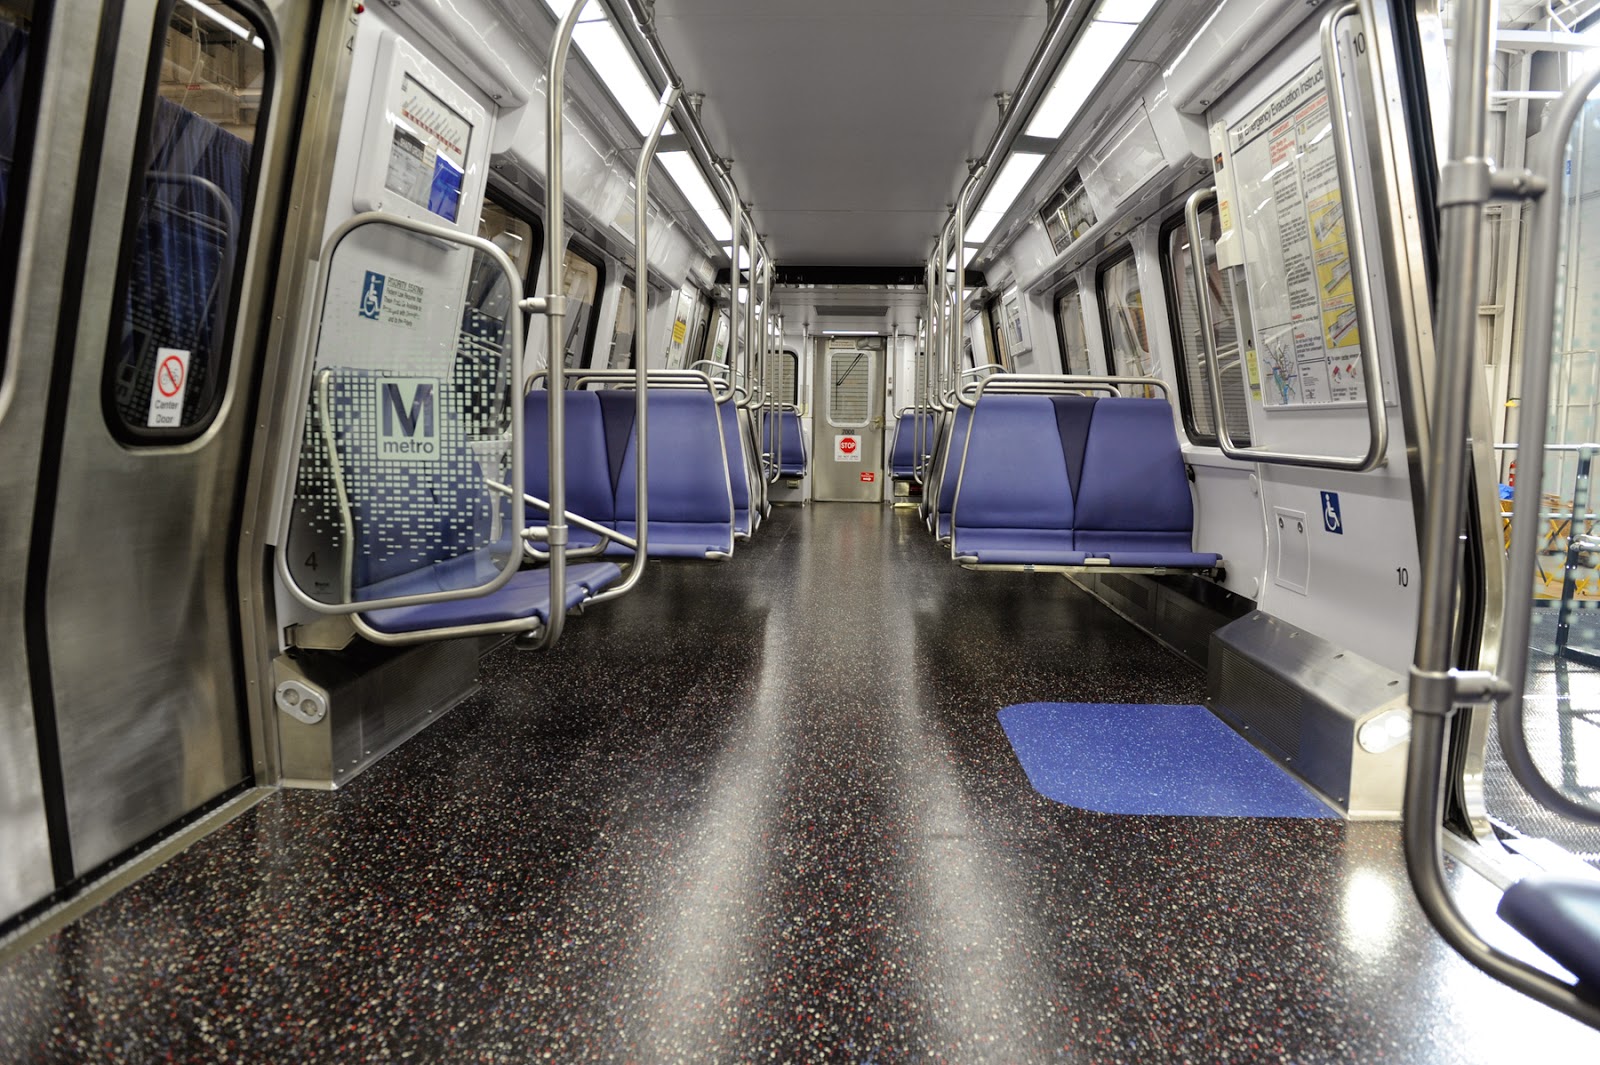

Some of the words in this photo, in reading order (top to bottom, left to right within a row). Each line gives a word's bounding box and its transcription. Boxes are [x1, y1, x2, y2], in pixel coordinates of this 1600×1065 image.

[1353, 32, 1366, 57] 10
[1244, 110, 1271, 137] Emergency
[1271, 87, 1300, 116] Evacuation
[1300, 67, 1324, 94] Instructi
[155, 400, 179, 410] Center
[382, 383, 434, 437] M
[155, 413, 174, 424] Door
[383, 439, 434, 453] metro
[304, 551, 318, 571] 4
[1396, 567, 1408, 587] 10
